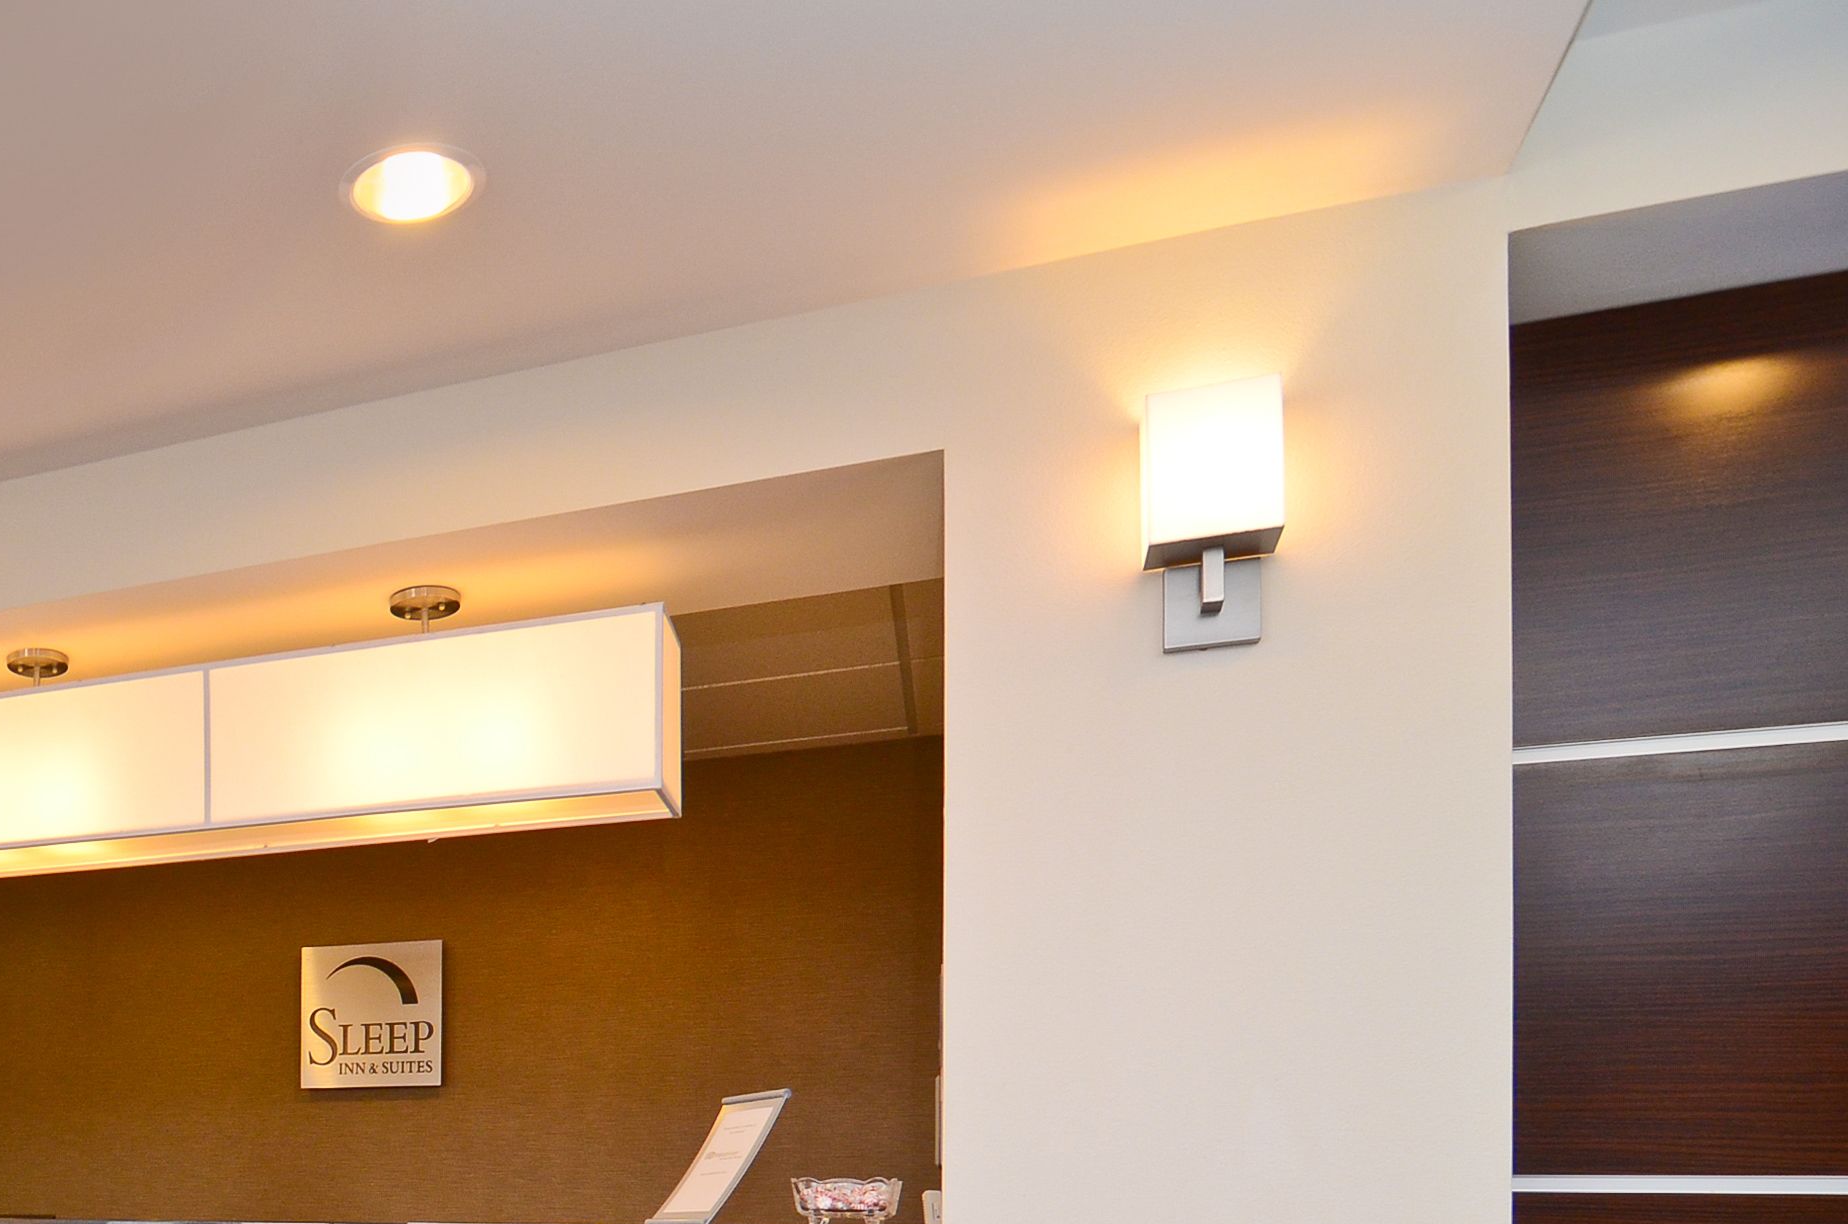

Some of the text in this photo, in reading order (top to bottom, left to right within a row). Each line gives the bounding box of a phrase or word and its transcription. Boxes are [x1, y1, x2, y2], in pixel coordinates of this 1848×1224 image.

[308, 1007, 434, 1066] SLEEP
[338, 1060, 434, 1075] INN & SUITES
